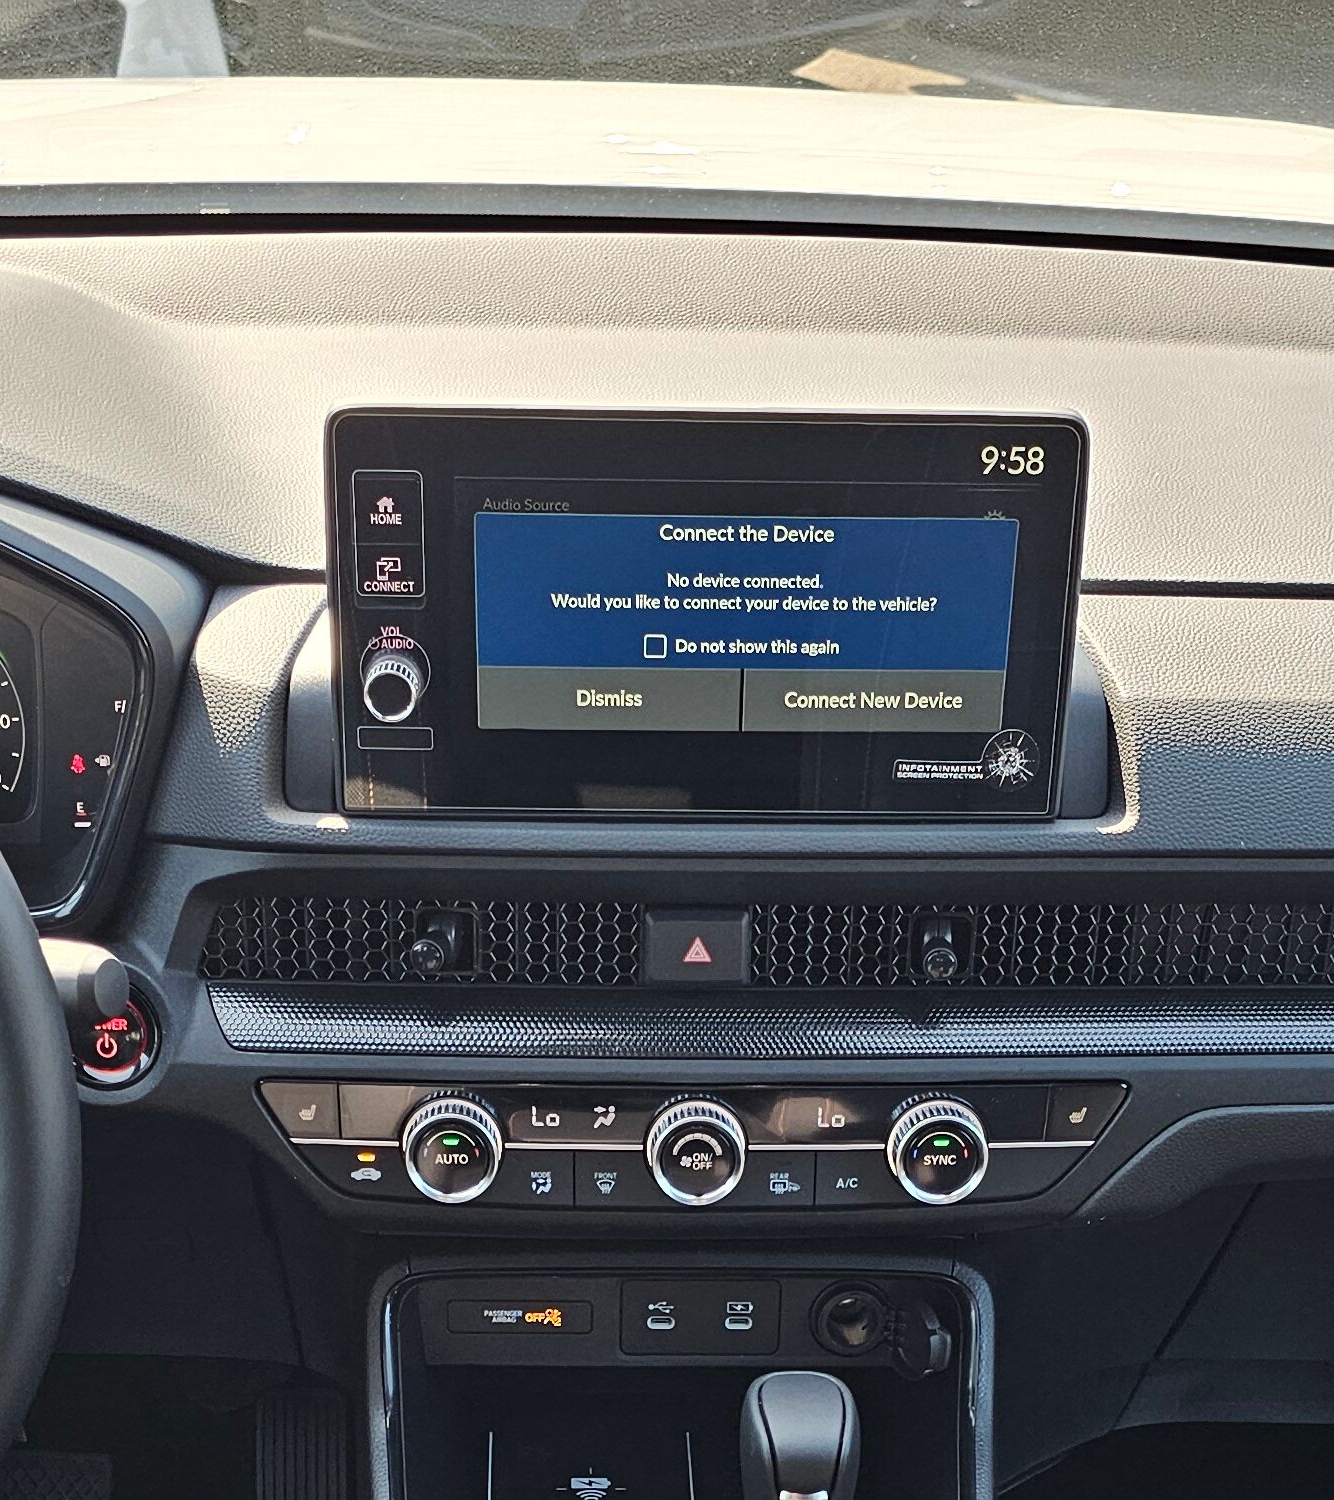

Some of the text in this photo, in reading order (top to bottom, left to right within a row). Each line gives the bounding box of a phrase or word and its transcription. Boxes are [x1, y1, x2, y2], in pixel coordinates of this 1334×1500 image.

[980, 445, 1045, 476] 9:58
[482, 497, 571, 512] Audio Source
[370, 513, 403, 525] HOME
[659, 524, 835, 544] Connect the Device
[363, 580, 415, 593] CONNECT
[667, 573, 824, 590] No device connected.
[551, 593, 938, 614] Would you like to connect your device to the vehicle?
[380, 626, 402, 637] VOL
[381, 638, 414, 650] AUDIO
[675, 639, 840, 657] Do not show this again
[575, 689, 644, 708] Dismiss
[783, 691, 963, 710] Connect New Device
[114, 701, 123, 713] F
[898, 764, 983, 773] INFOTAINMENT
[76, 802, 84, 813] E
[435, 1154, 469, 1166] AUTO
[923, 1154, 957, 1167] SYNC
[692, 1162, 713, 1171] OFF
[530, 1171, 552, 1179] MODE
[594, 1172, 617, 1180] FRONT
[835, 1177, 858, 1190] A/C
[524, 1312, 546, 1323] OFF
